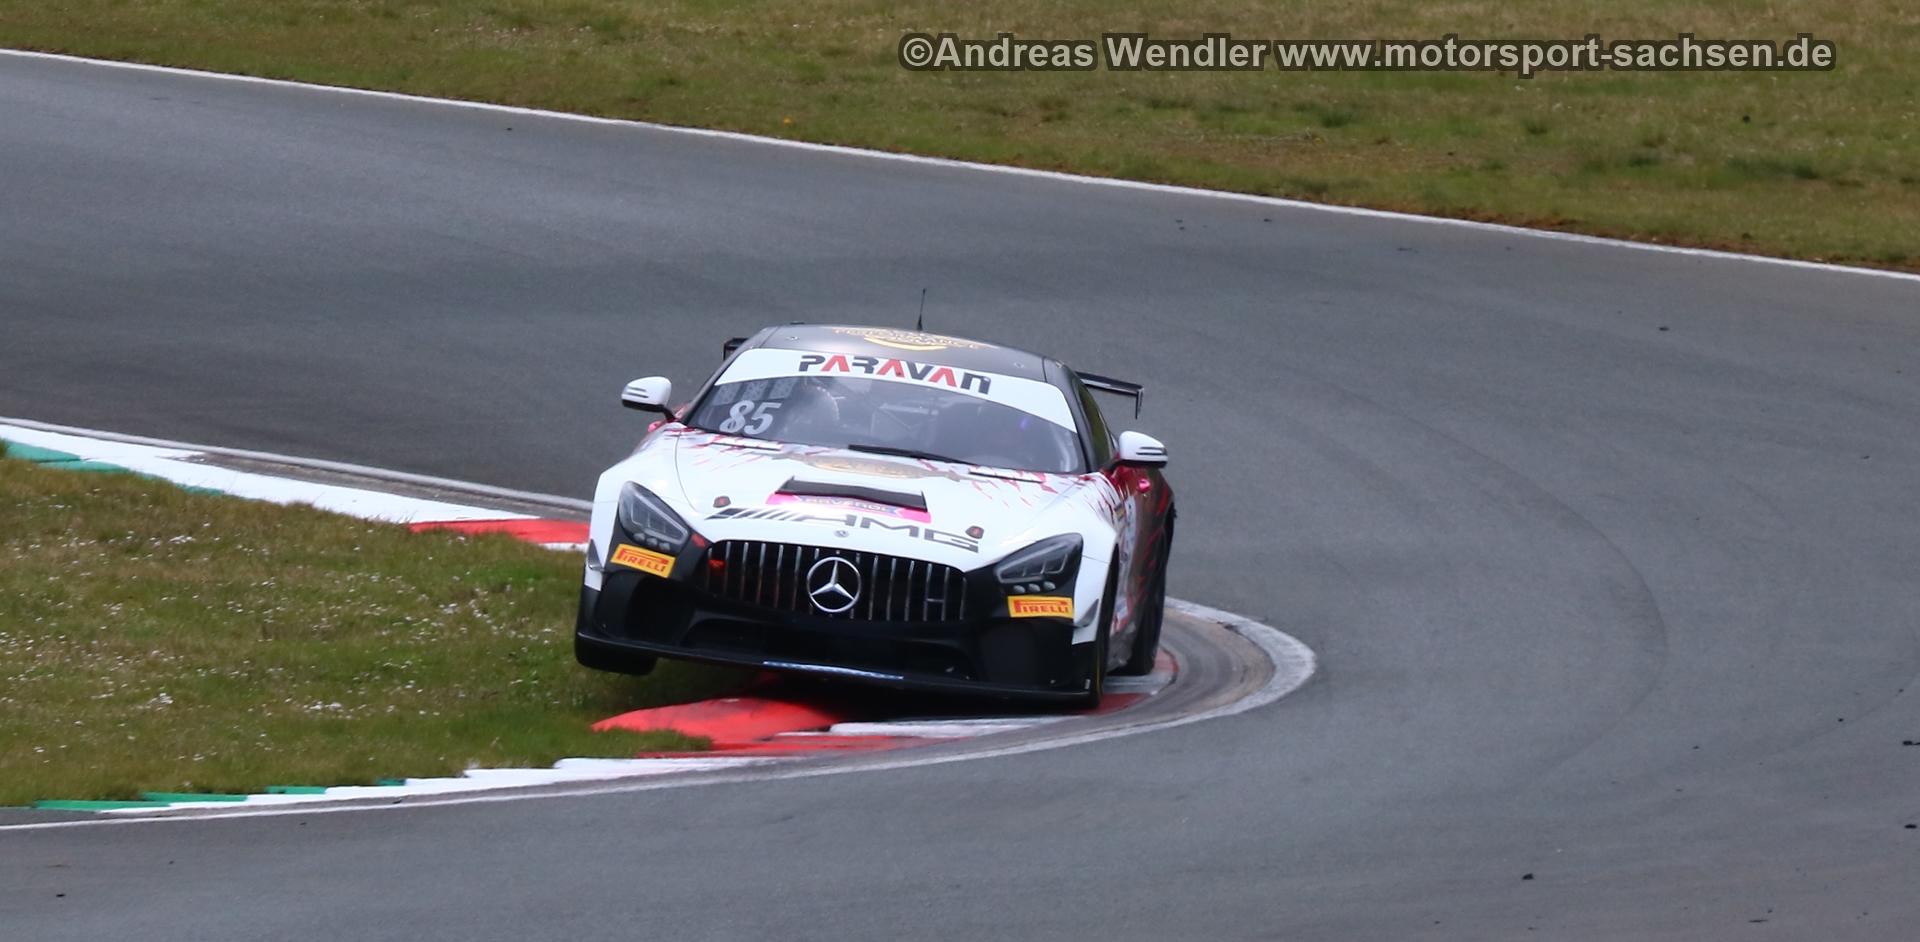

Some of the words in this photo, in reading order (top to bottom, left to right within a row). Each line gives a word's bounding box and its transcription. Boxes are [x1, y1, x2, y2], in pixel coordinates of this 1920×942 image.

[798, 354, 991, 395] PARAVAN
[719, 399, 782, 435] 85
[616, 547, 670, 573] PIRELLI
[1013, 599, 1070, 614] PIRELLI
